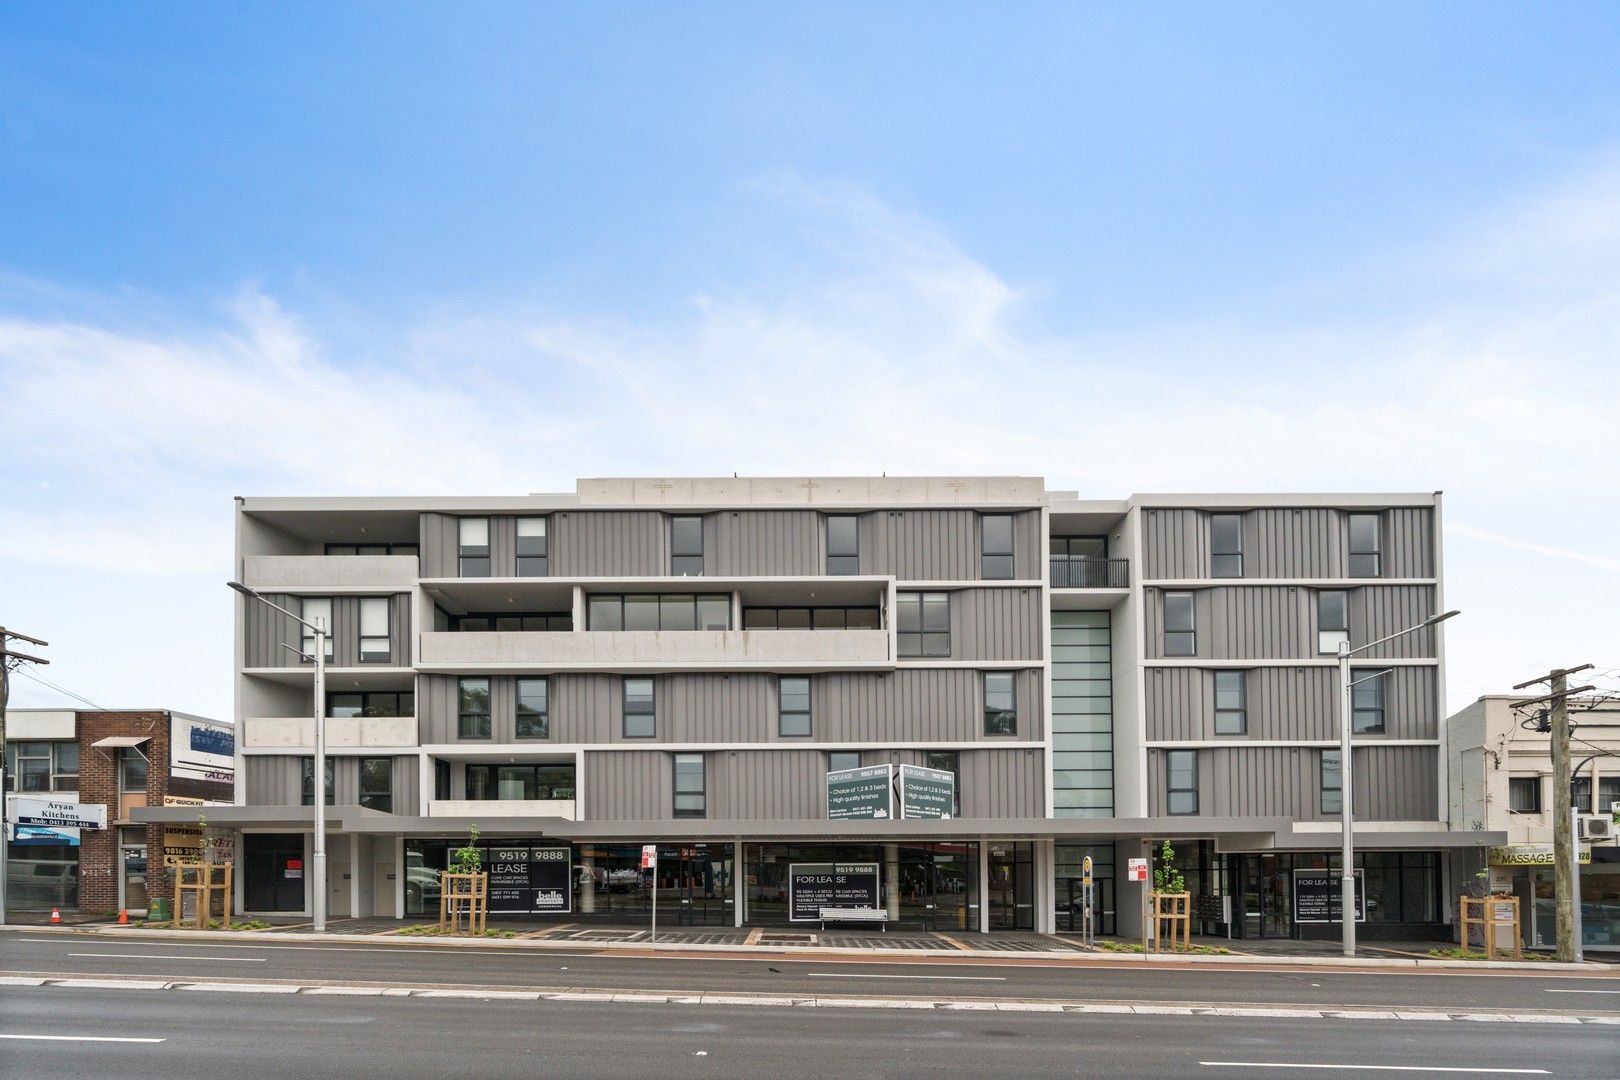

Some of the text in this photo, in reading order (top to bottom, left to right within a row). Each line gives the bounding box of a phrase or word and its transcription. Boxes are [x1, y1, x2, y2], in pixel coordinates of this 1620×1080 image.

[42, 811, 80, 819] Kitchens
[500, 852, 563, 860] 9519 9888
[1502, 854, 1554, 864] MASSAGE
[491, 864, 528, 873] LEASE
[538, 891, 562, 899] belle
